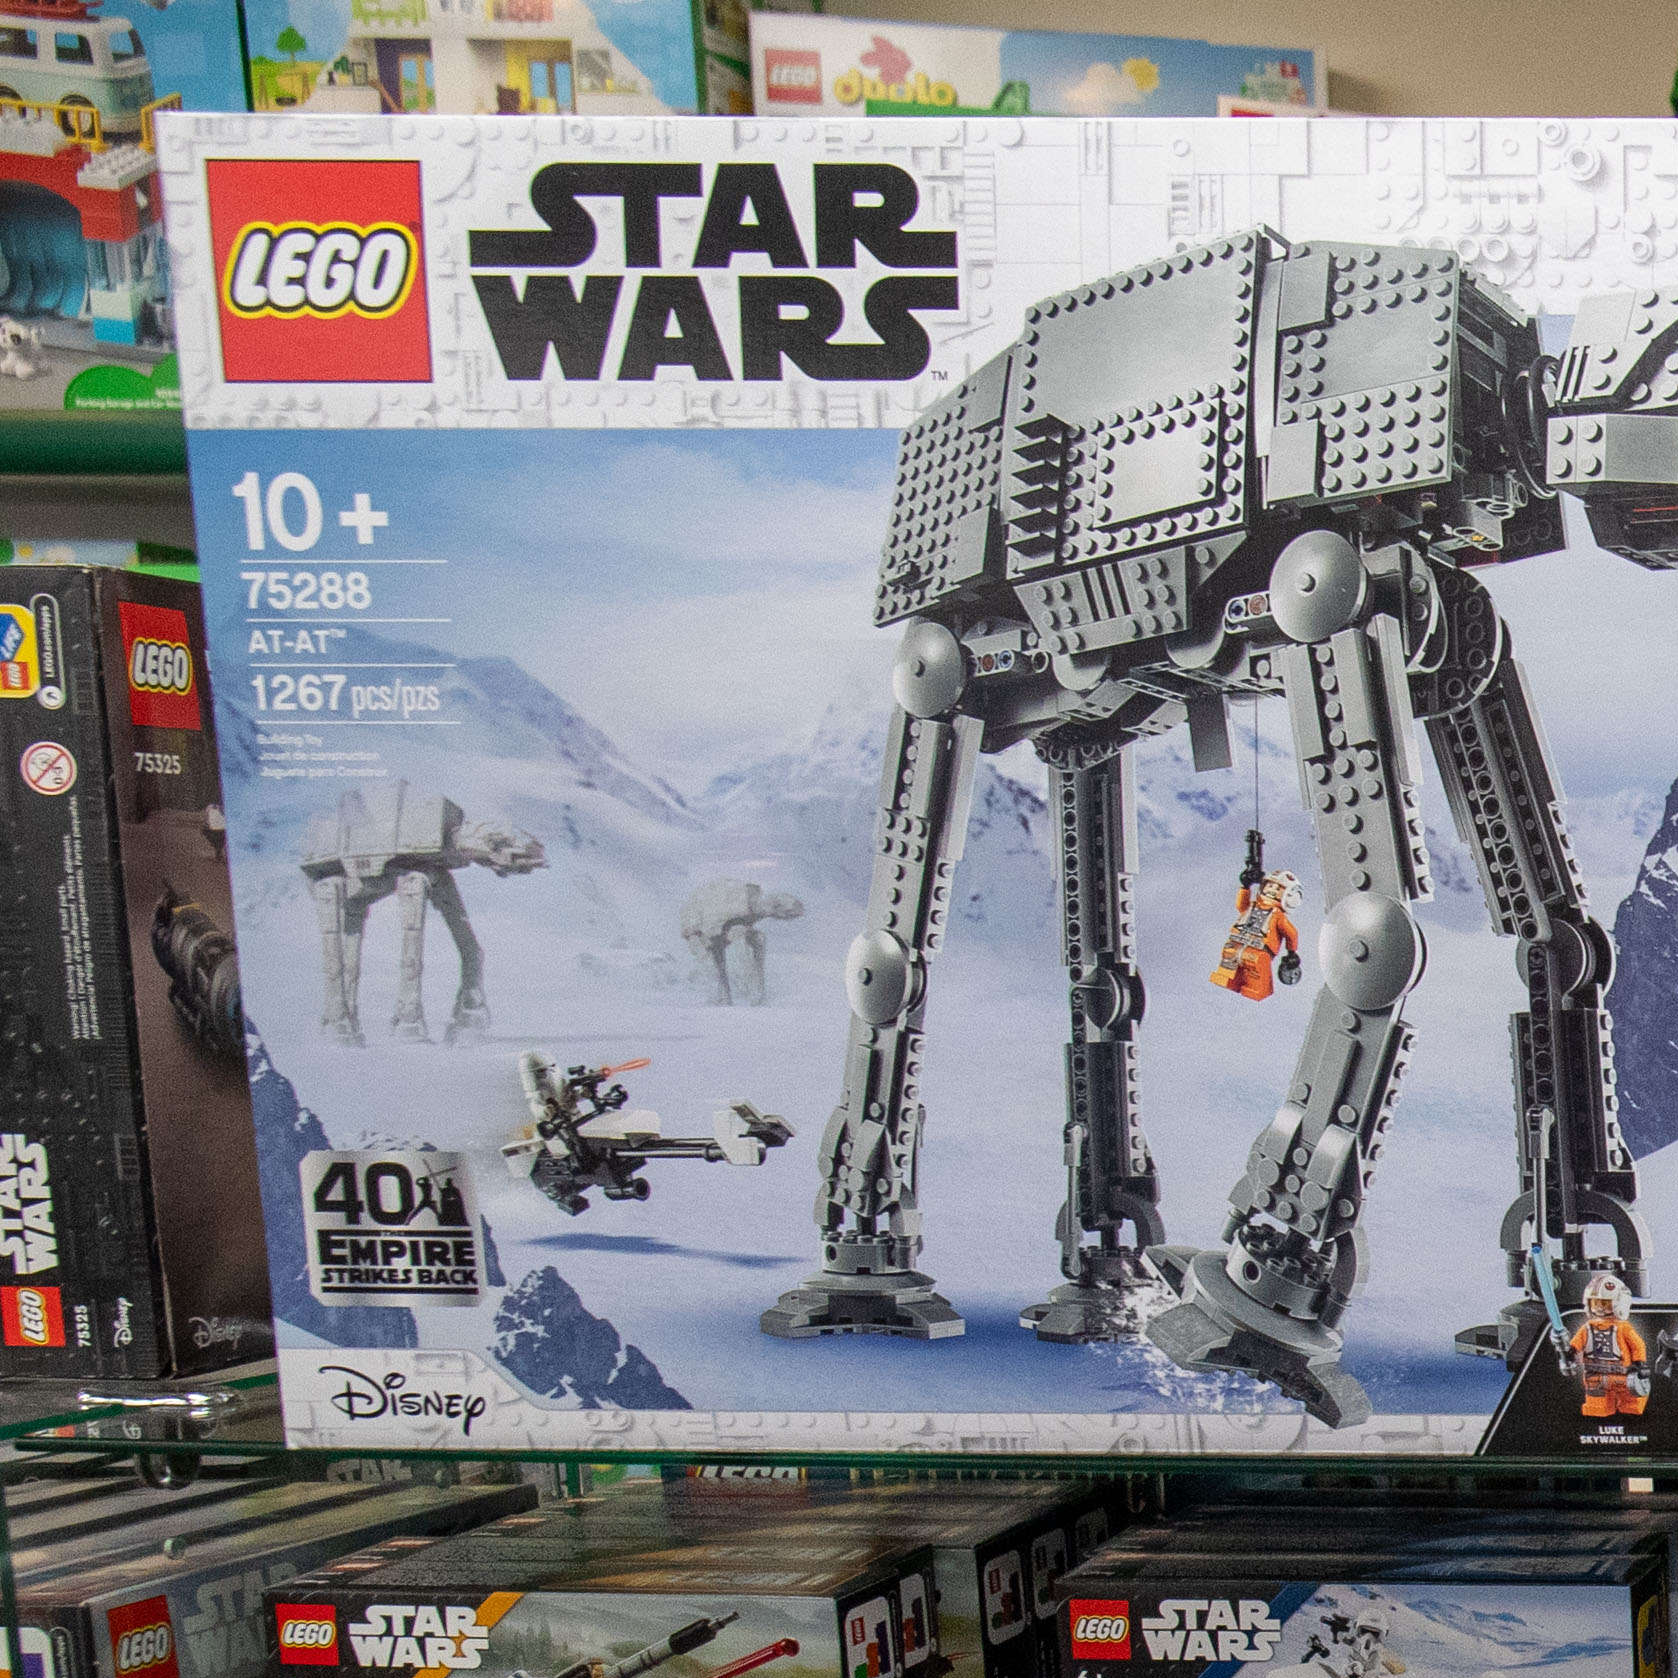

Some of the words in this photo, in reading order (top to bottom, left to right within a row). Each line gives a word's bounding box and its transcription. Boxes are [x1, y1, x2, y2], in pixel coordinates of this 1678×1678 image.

[469, 162, 957, 268] STAR
[232, 229, 408, 311] LEGO
[470, 275, 958, 380] WARS
[241, 572, 371, 609] 75288
[132, 641, 191, 690] LEGO
[252, 675, 347, 711] 1267
[351, 678, 440, 717] pcs/pzs
[135, 752, 181, 774] 75325
[314, 1162, 415, 1225] 40
[317, 1230, 476, 1266] EMPIRE
[321, 1268, 412, 1283] STRIKES
[417, 1269, 478, 1284] BACK
[319, 1366, 486, 1436] Disney
[1599, 1426, 1624, 1436] LUKE
[347, 1605, 489, 1636] STAR
[1075, 1618, 1128, 1642] LEGO
[1142, 1599, 1281, 1631] STAR
[283, 1621, 335, 1648] LEGO
[1142, 1630, 1282, 1662] WARS
[349, 1636, 489, 1668] WARS
